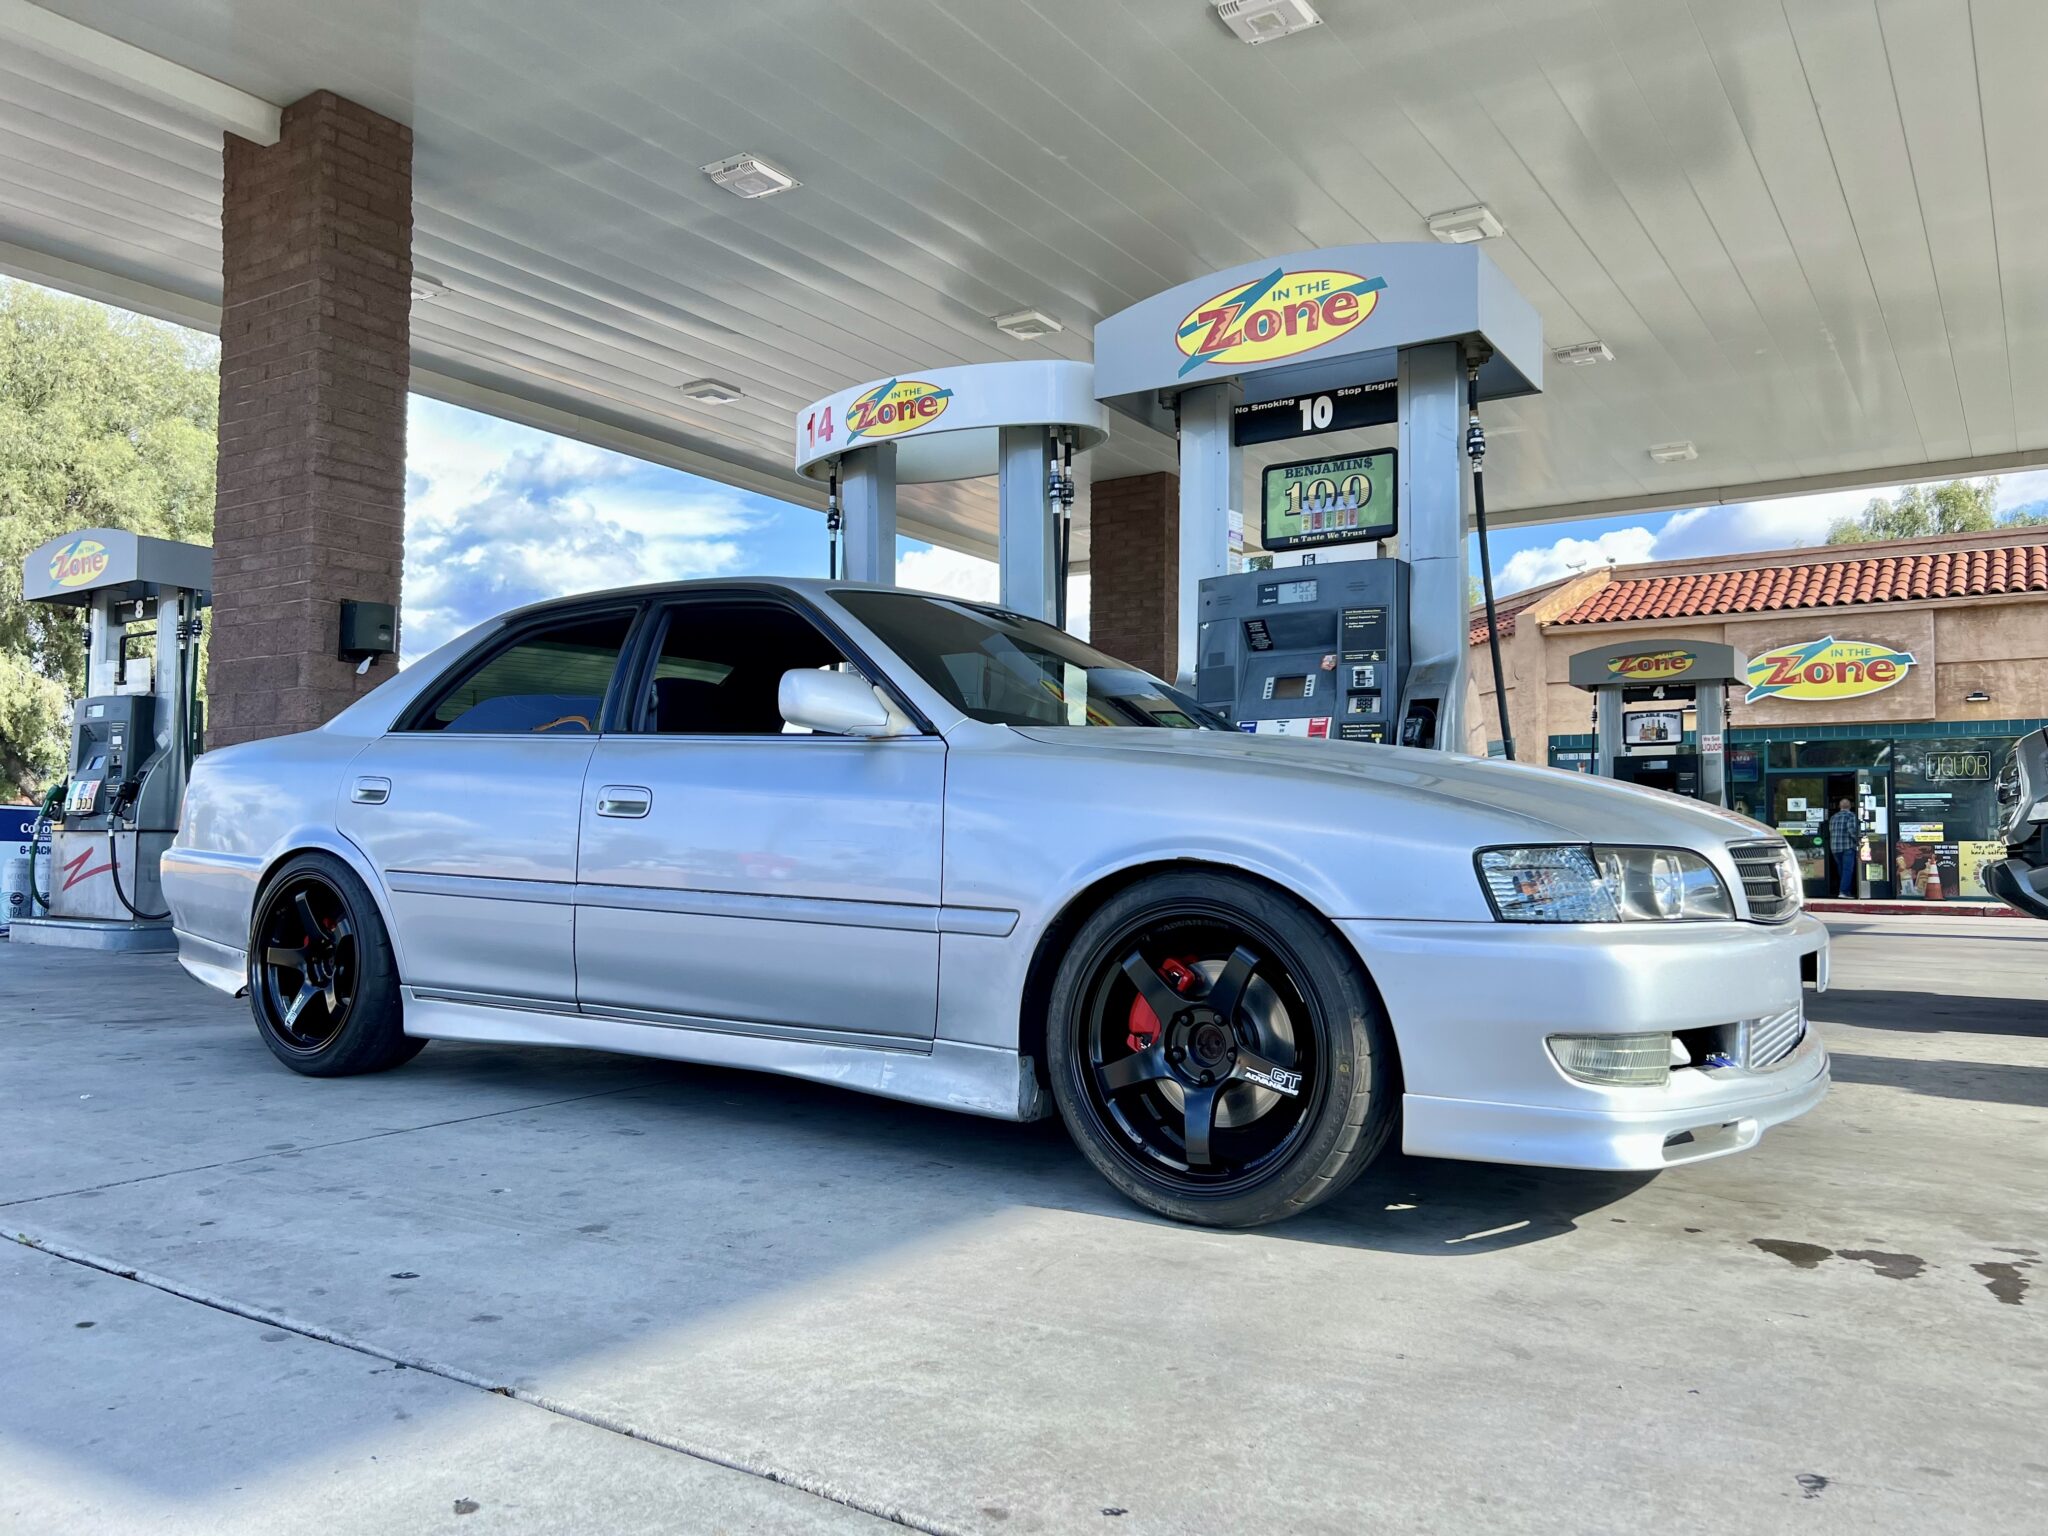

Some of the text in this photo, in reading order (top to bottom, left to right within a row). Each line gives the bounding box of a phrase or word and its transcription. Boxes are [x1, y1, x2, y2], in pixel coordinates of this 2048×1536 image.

[1272, 279, 1331, 301] IN THE
[1197, 291, 1360, 355] Zone
[891, 387, 922, 399] IN THE
[1337, 387, 1362, 397] Stop
[855, 395, 938, 430] Zone
[1235, 398, 1295, 414] No Smoking
[1299, 395, 1334, 432] 10
[807, 405, 834, 449] 14
[1284, 473, 1373, 516] 100
[1289, 529, 1367, 544] In Taste We Trust
[55, 553, 104, 579] Zone
[135, 600, 144, 619] 8
[1830, 648, 1872, 657] IN THE
[1618, 656, 1687, 672] Zone
[1765, 655, 1896, 685] Zone
[1652, 686, 1665, 699] 4
[1630, 712, 1660, 721] AVAILABLE
[1928, 755, 1988, 777] LIQUOR
[1271, 1067, 1303, 1089] GT
